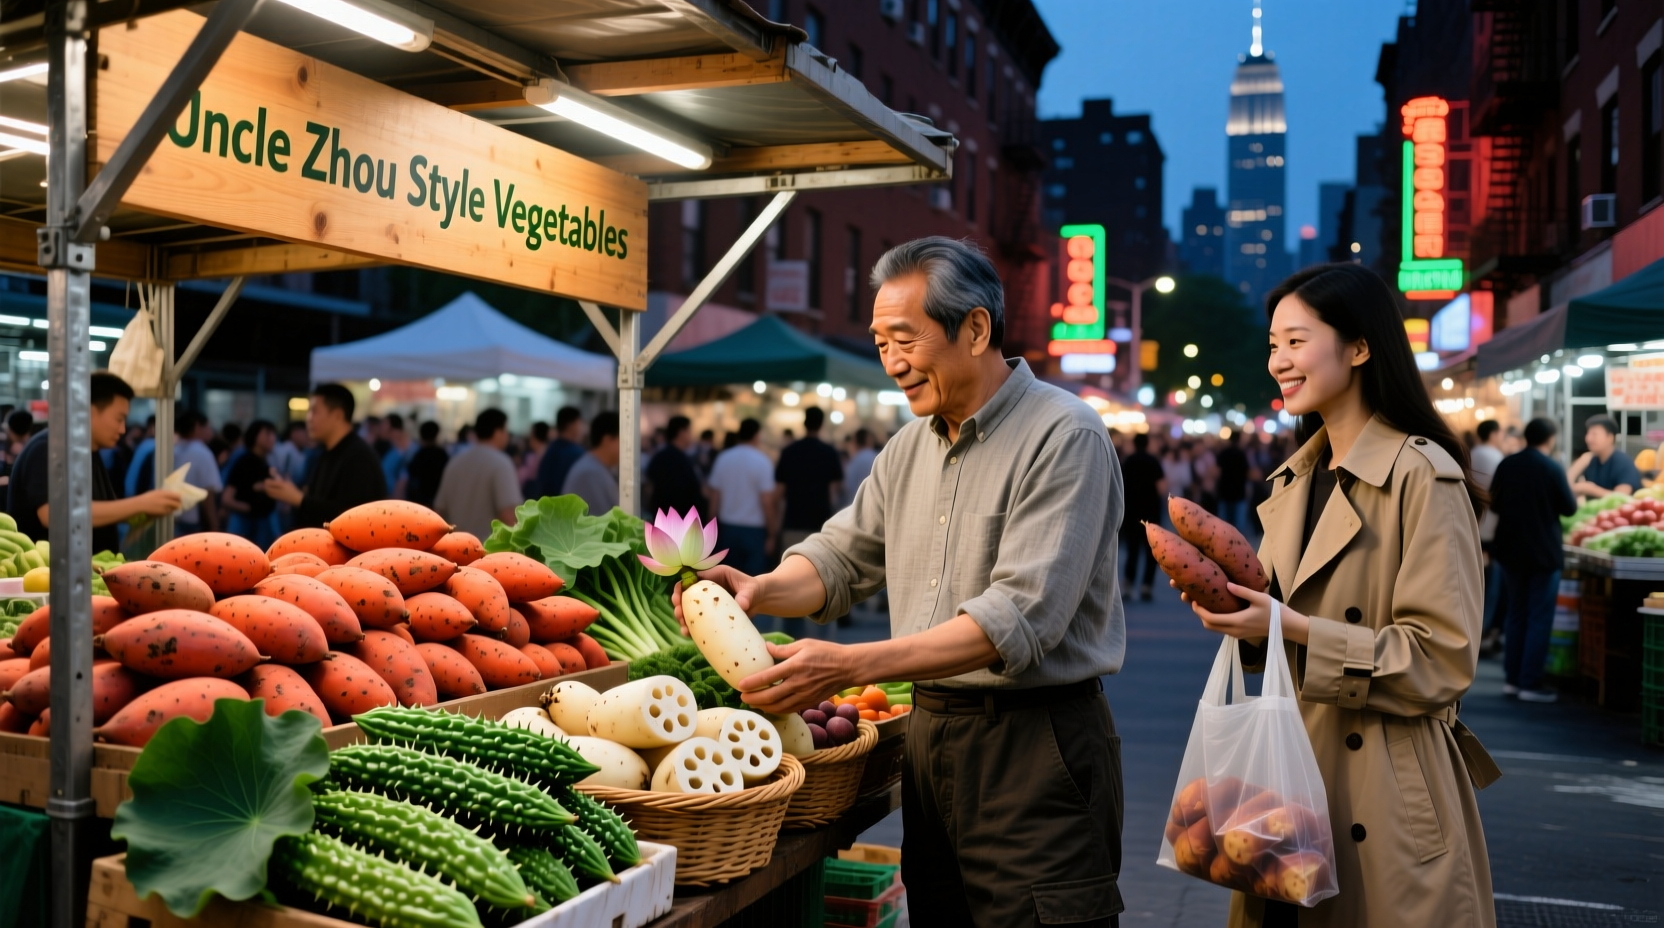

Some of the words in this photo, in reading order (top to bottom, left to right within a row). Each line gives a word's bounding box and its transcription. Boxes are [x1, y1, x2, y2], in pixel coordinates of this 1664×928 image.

[167, 89, 291, 173] Uncle
[301, 120, 397, 200] Zhou
[407, 154, 485, 230] Style
[493, 178, 628, 260] Vegetables
